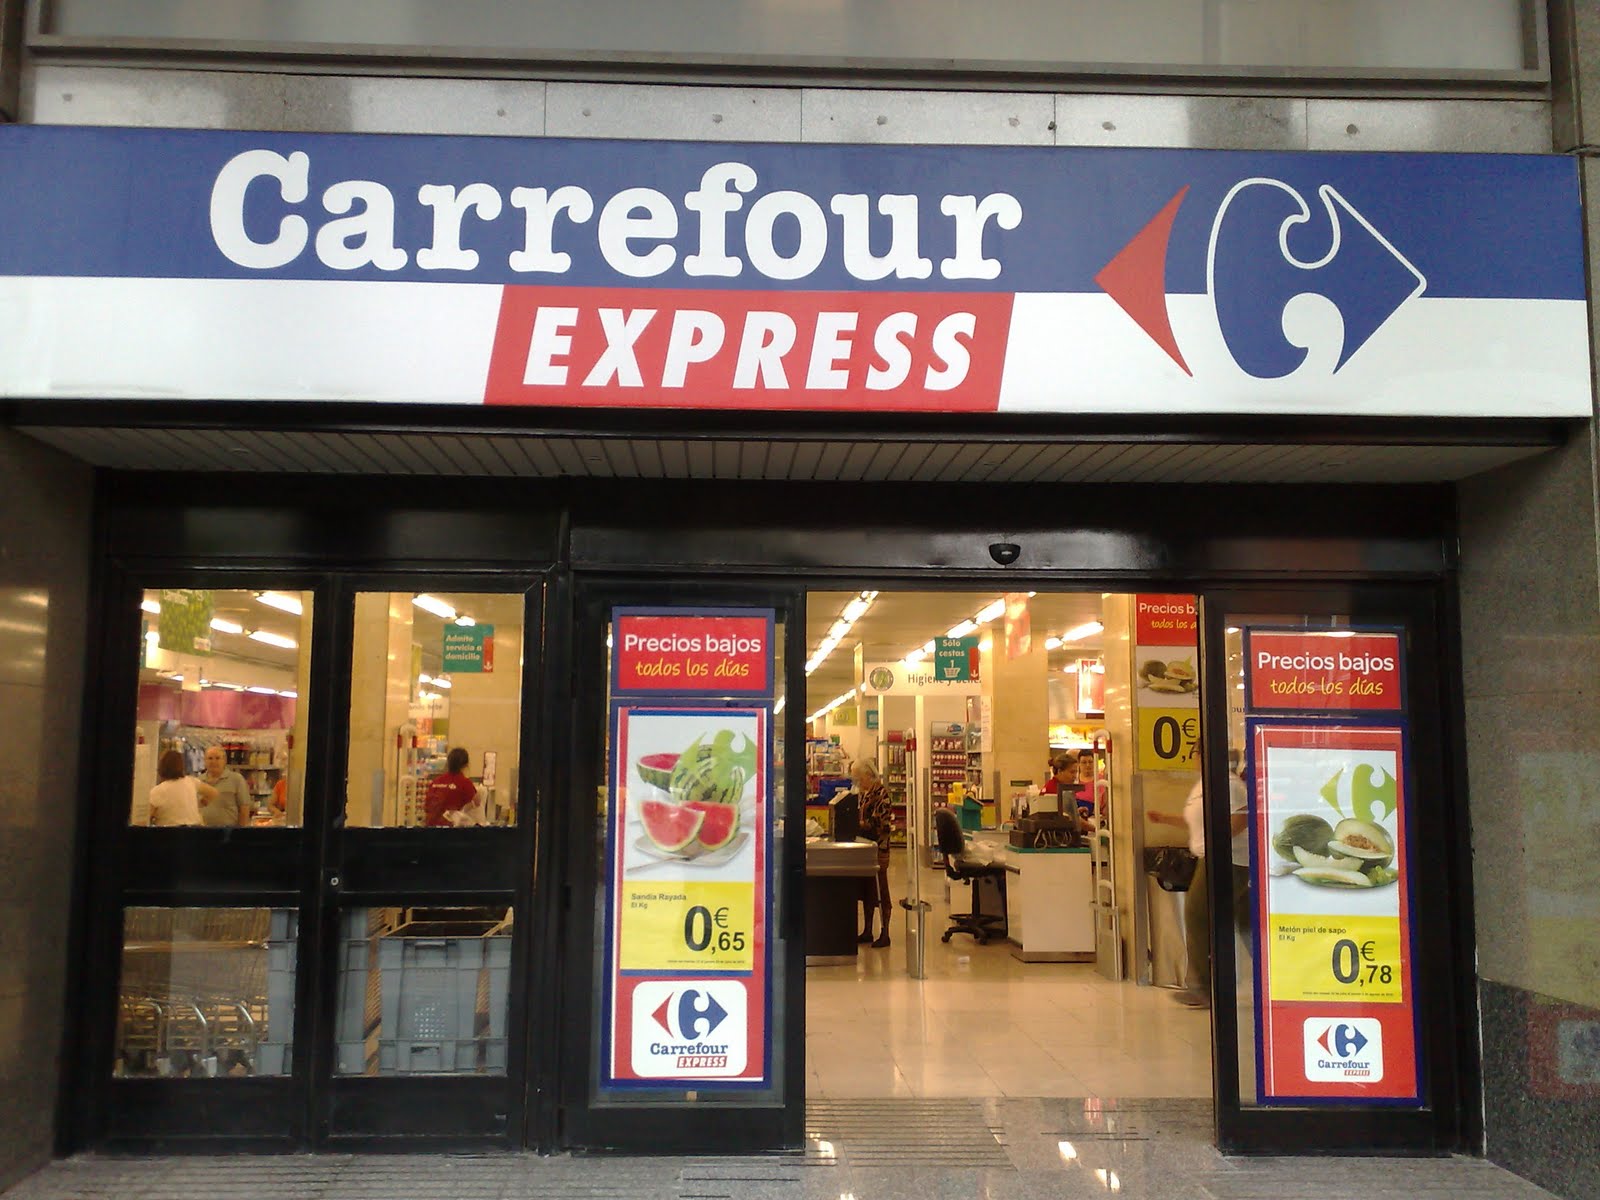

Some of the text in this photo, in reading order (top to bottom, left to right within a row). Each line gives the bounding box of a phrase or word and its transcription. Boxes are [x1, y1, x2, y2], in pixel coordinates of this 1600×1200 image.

[209, 149, 1022, 282] Carrefour
[522, 306, 977, 392] EXPRESS
[1139, 602, 1185, 614] Precios
[1151, 618, 1174, 629] todos
[1176, 618, 1188, 629] los
[624, 634, 762, 656] Precios bajos
[939, 649, 965, 657] cestas
[635, 658, 750, 677] todos los días
[1257, 651, 1395, 675] Precios bajos
[1270, 676, 1384, 695] todos los días
[658, 893, 687, 902] Rayada
[1302, 926, 1316, 935] piel
[1317, 926, 1327, 934] de
[1328, 928, 1347, 936] sapo
[650, 1042, 728, 1055] Carrefour
[677, 1056, 726, 1067] EXPRESS
[1317, 1059, 1370, 1069] Carrefour
